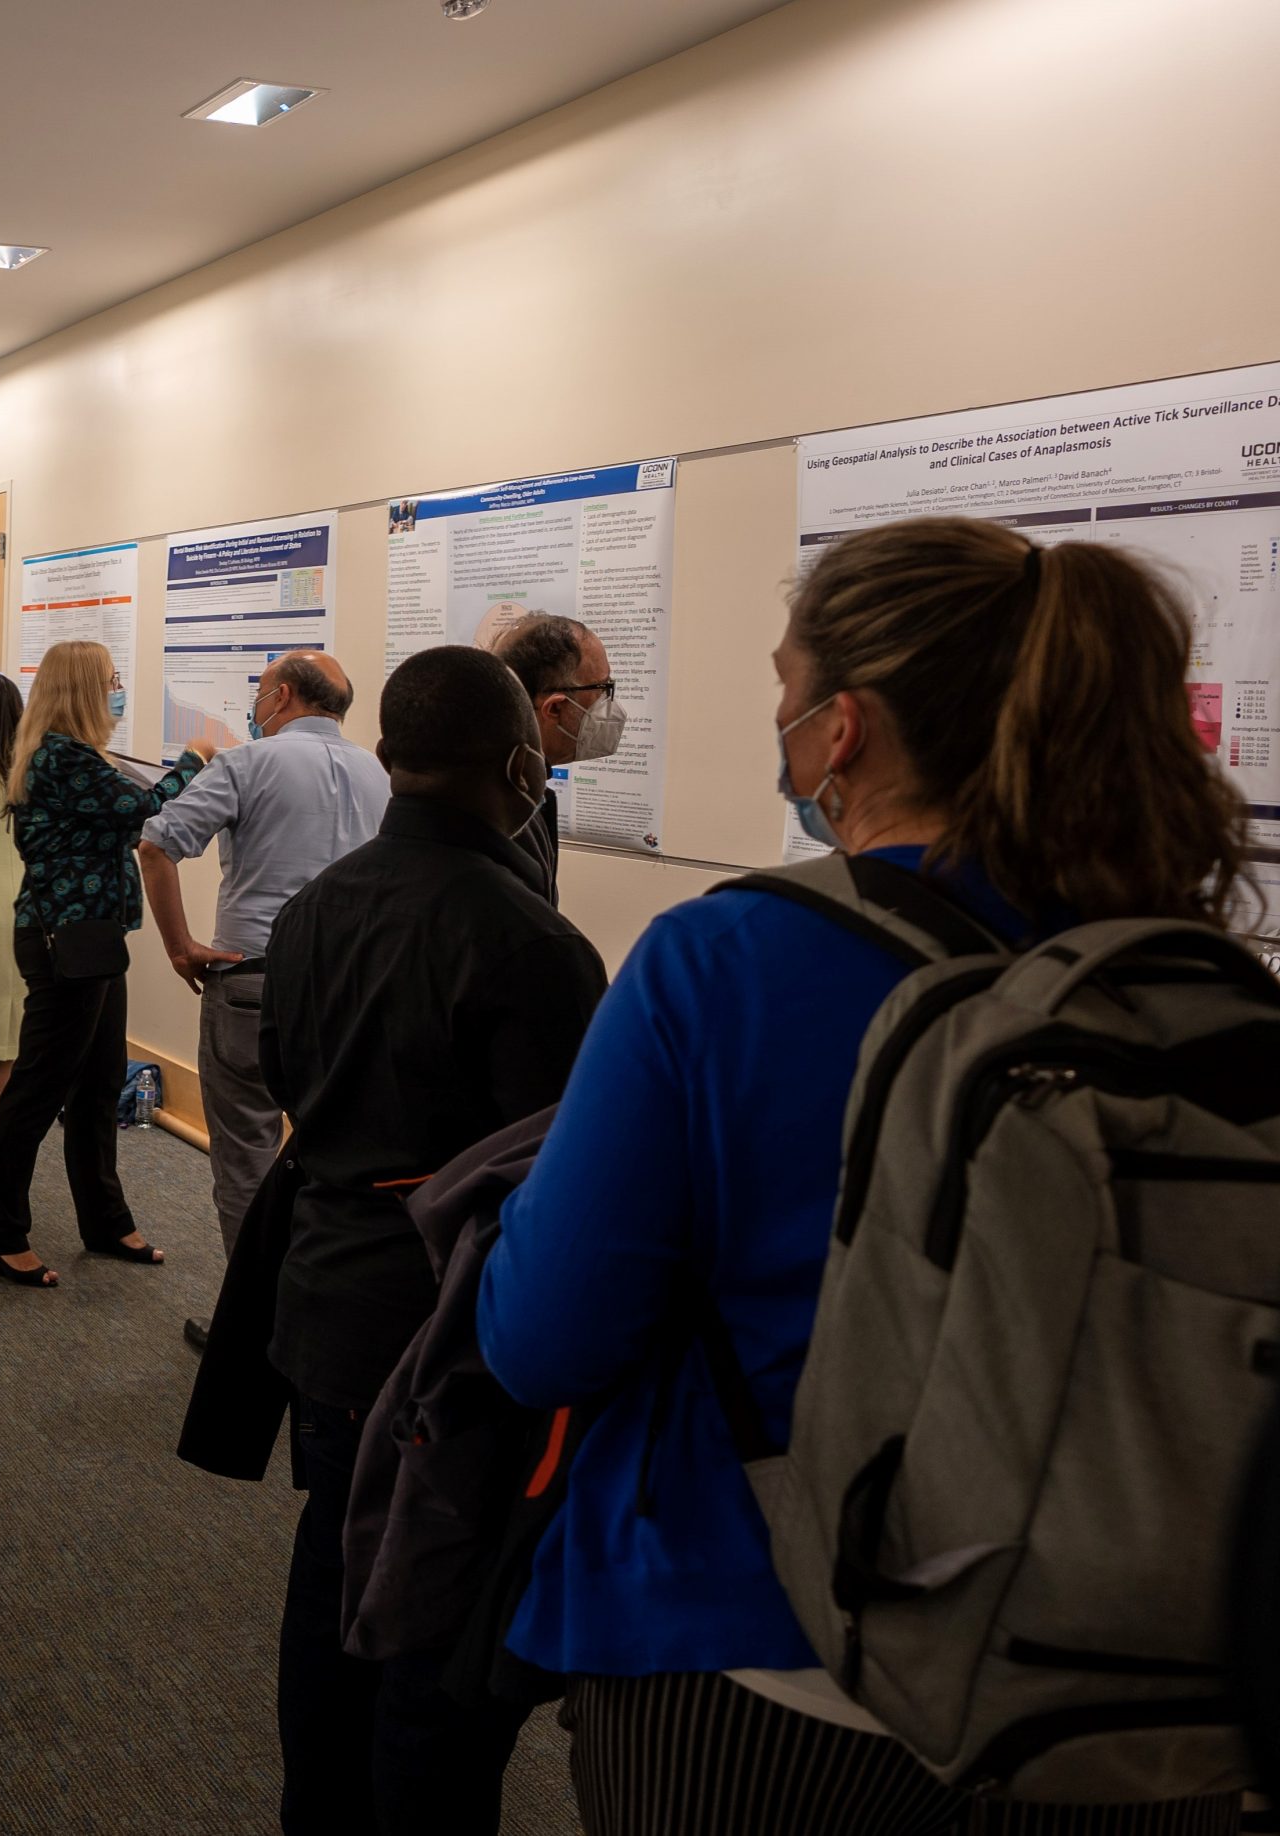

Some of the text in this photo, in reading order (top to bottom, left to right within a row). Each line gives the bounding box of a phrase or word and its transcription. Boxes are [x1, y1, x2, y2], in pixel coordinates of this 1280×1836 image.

[807, 459, 830, 470] Using
[832, 450, 878, 466] Geospatial
[880, 446, 917, 460] Analysis
[919, 444, 930, 454] to
[931, 438, 974, 453] Describe
[976, 436, 994, 446] the
[996, 426, 1056, 444] Association
[1060, 420, 1110, 436] between
[1113, 414, 1151, 428] Active
[1154, 408, 1180, 422] Tick
[1182, 400, 1264, 419] Surveillance
[929, 437, 1112, 470] and Clinical Cases of Anaplasmosis
[642, 463, 668, 473] UCONN
[950, 484, 969, 493] Grace
[999, 479, 1020, 488] Marco
[1059, 472, 1079, 481] David
[1010, 486, 1040, 495] Department
[1048, 483, 1074, 493] Psychiatry,
[1076, 480, 1102, 489] University
[1111, 476, 1146, 485] Connecticut,
[1148, 472, 1183, 482] Farmington,
[1018, 495, 1042, 503] University
[1050, 491, 1081, 500] Connecticut
[1109, 485, 1136, 494] Medicine,
[1138, 482, 1172, 491] Farmington,
[1179, 502, 1205, 510] CHANGES
[226, 540, 238, 548] During
[274, 534, 293, 542] Licensing
[299, 530, 315, 538] Relation
